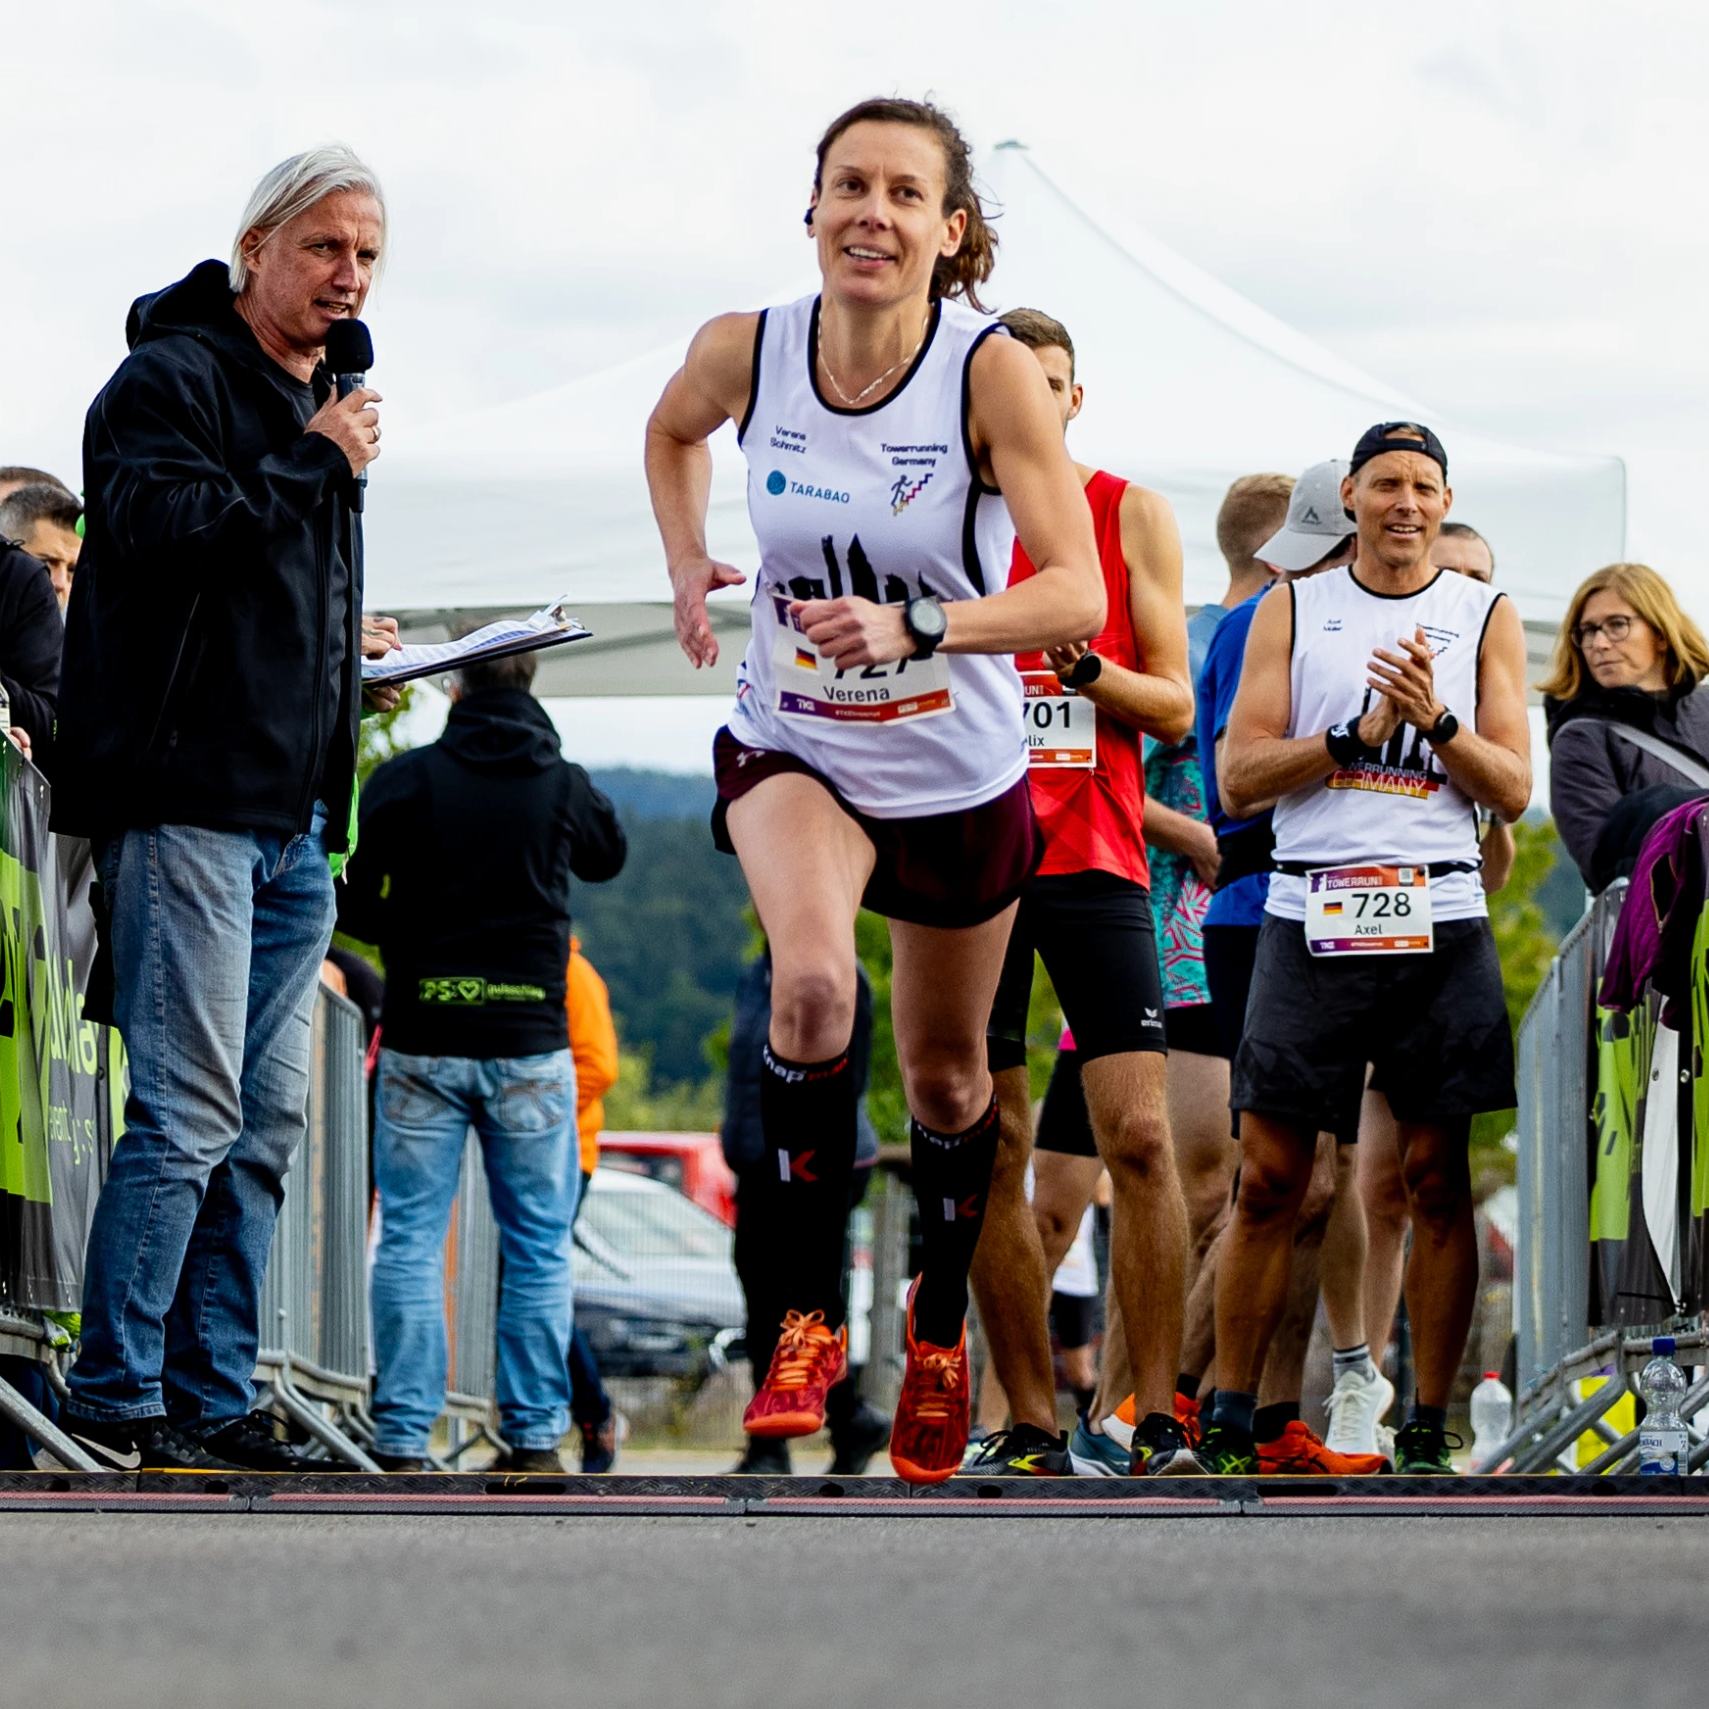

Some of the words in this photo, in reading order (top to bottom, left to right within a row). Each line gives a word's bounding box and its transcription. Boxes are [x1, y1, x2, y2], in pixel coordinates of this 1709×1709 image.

[775, 425, 807, 441] Verena
[770, 437, 807, 455] Schmitz
[880, 443, 949, 455] Towerrunning
[891, 456, 937, 468] Germany
[823, 686, 890, 703] Verena
[1027, 734, 1045, 747] lix
[1351, 892, 1412, 918] 728
[1354, 923, 1383, 936] Axel
